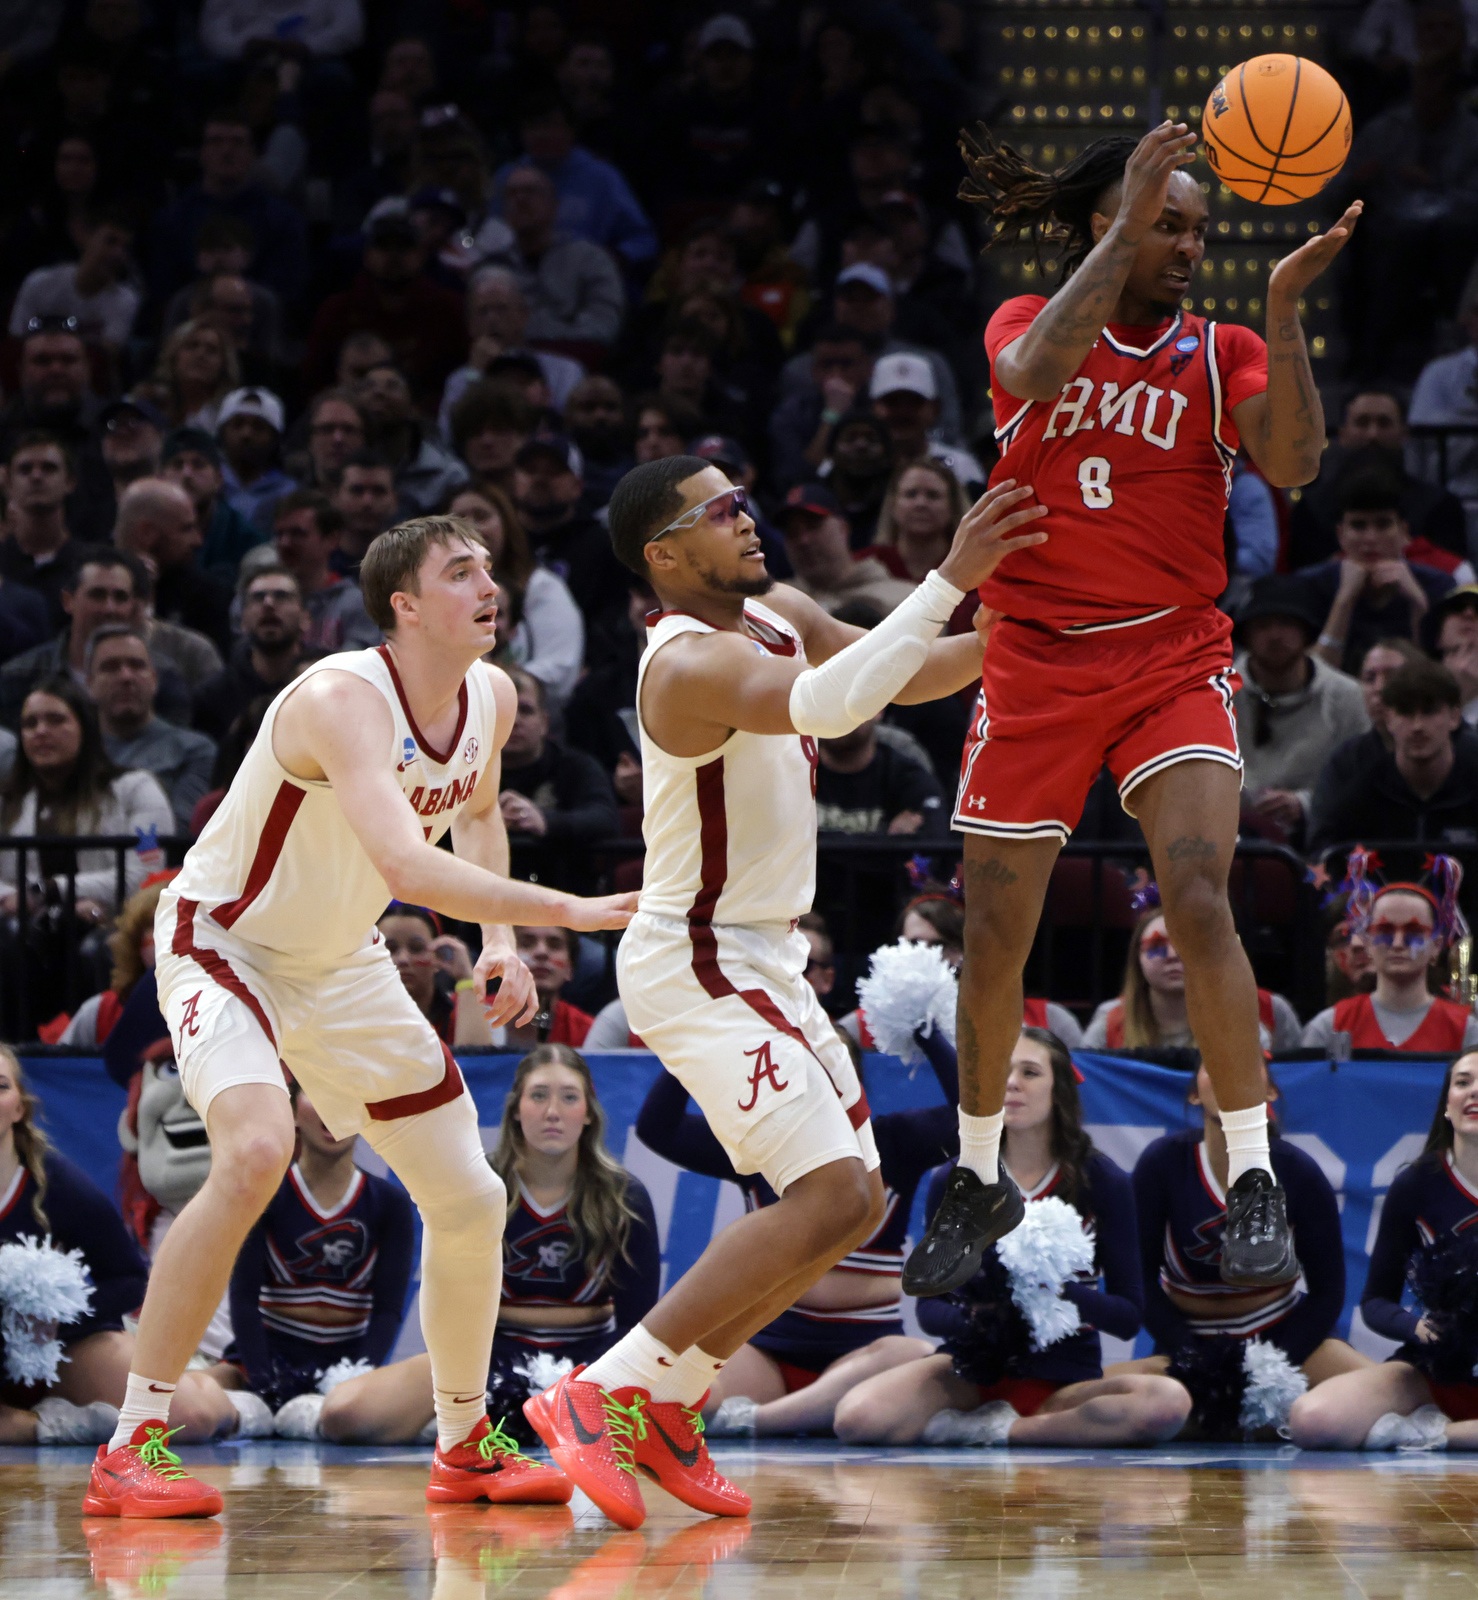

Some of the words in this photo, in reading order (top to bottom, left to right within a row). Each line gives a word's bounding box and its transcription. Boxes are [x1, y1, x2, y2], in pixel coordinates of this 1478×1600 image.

[1041, 376, 1188, 451] RMU
[1077, 456, 1114, 509] 8
[738, 1040, 788, 1111] A
